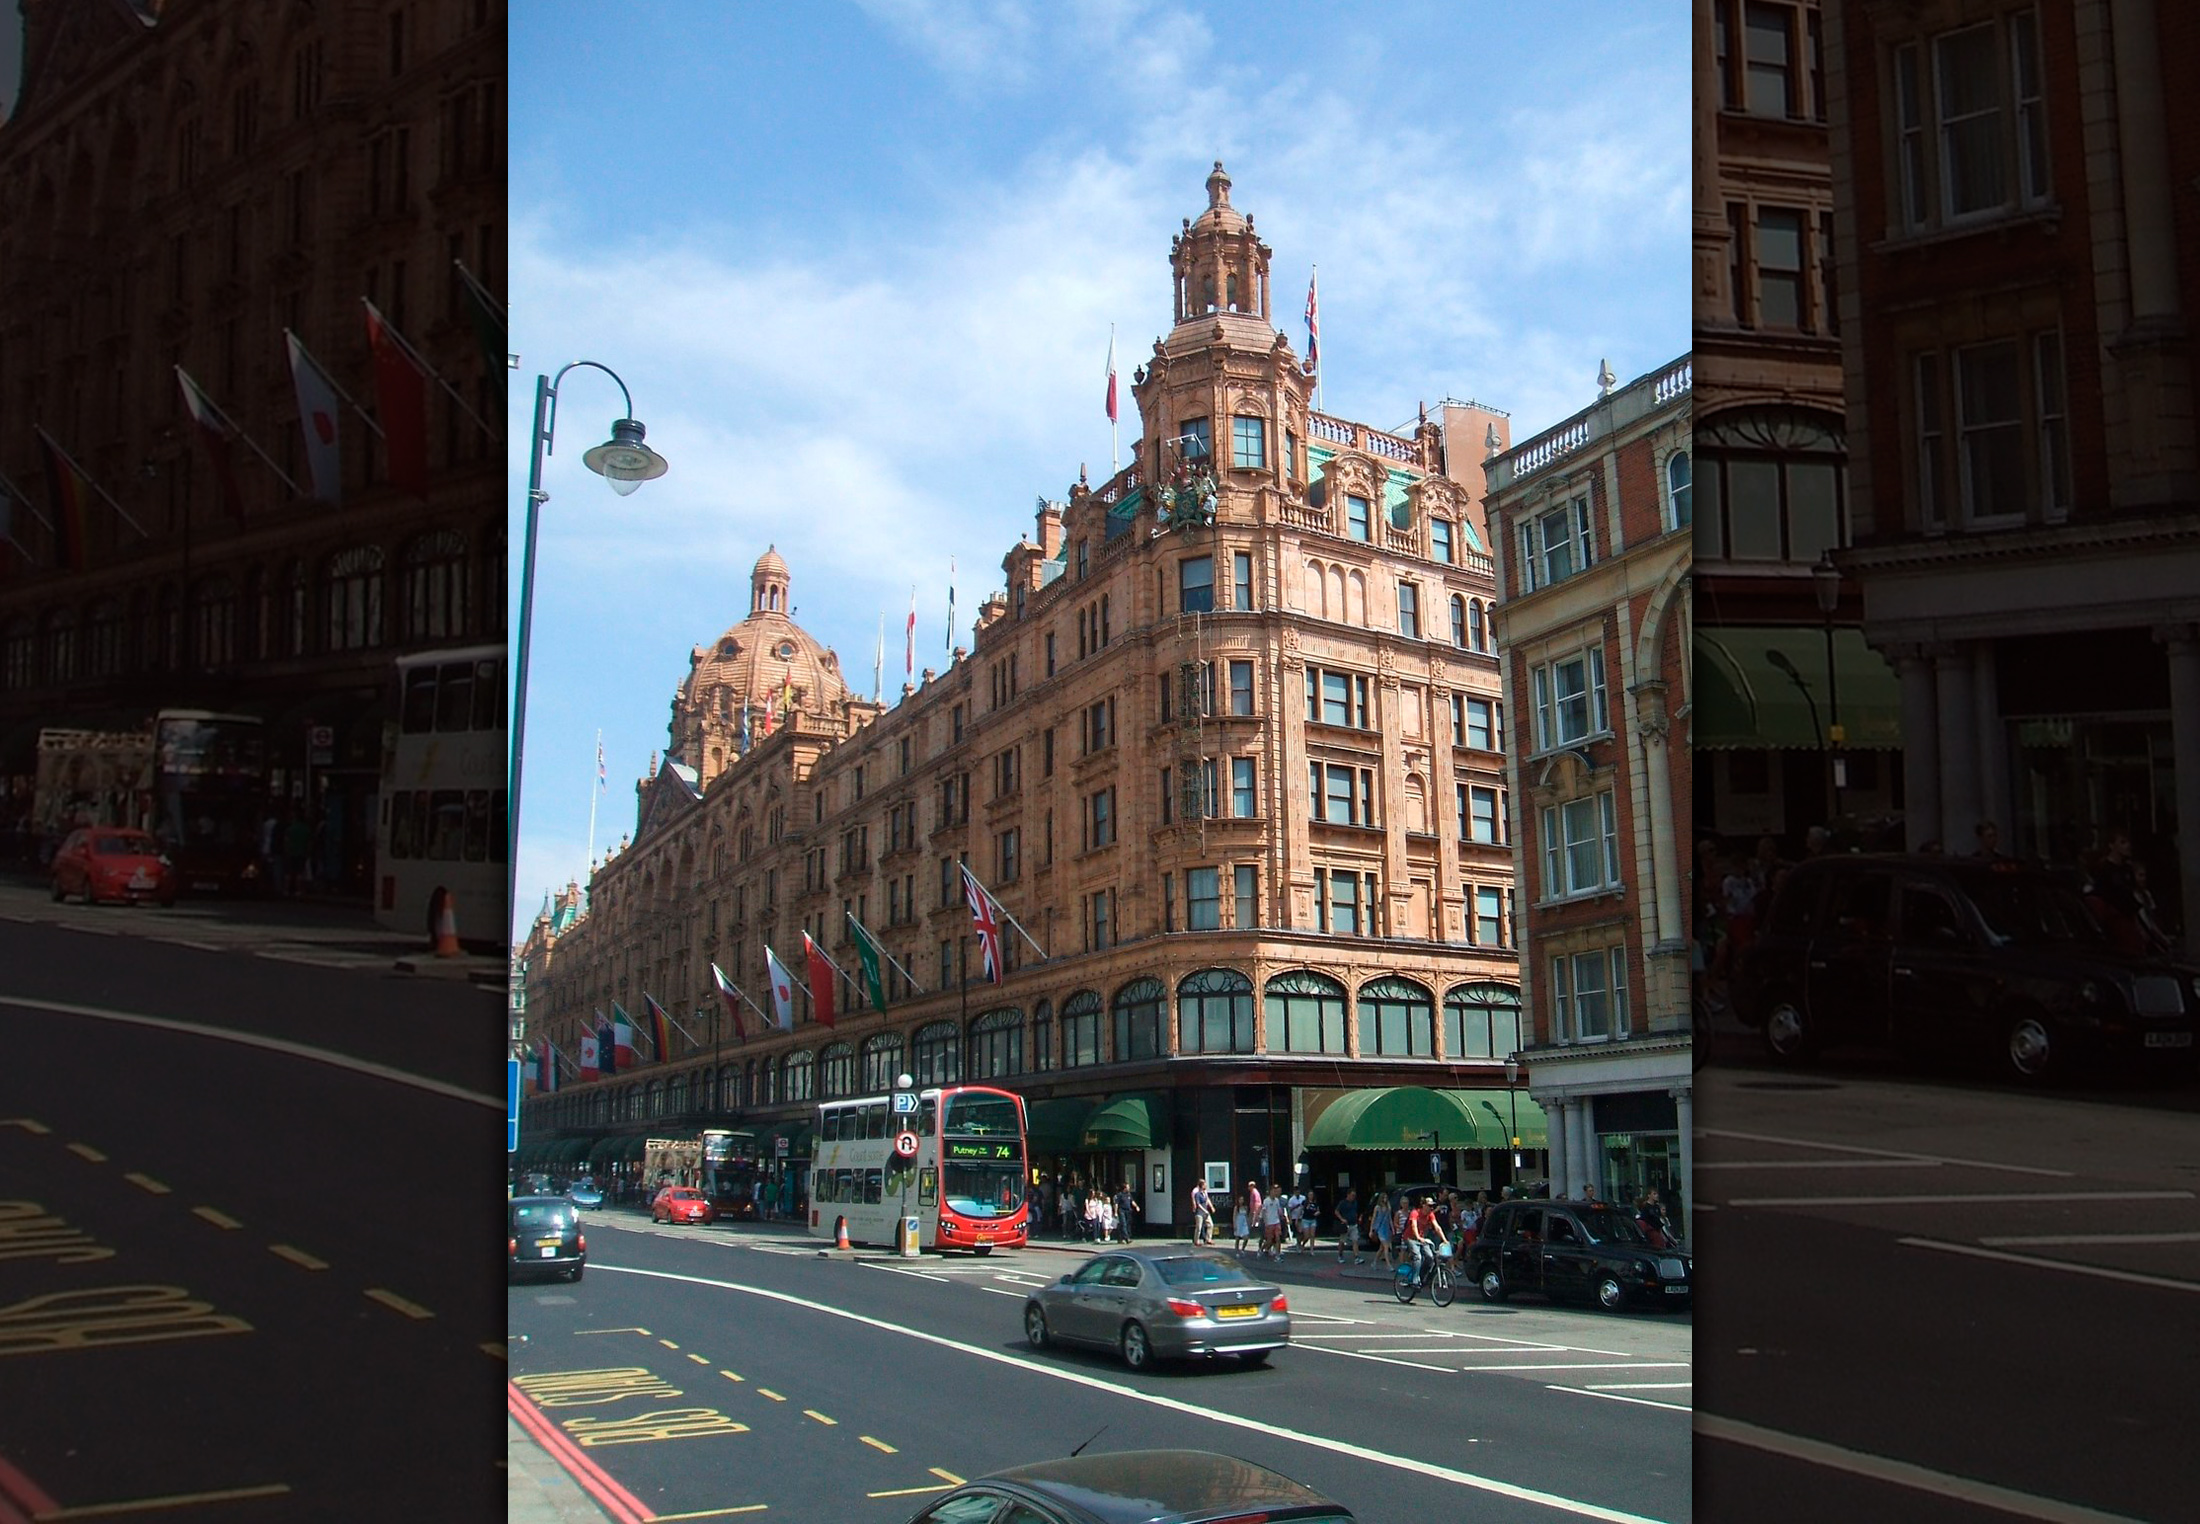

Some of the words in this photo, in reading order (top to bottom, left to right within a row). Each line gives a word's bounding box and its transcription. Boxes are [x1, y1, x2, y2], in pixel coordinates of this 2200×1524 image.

[897, 1096, 907, 1109] P
[953, 1146, 978, 1156] Putney
[996, 1146, 1010, 1158] 74
[561, 1408, 750, 1446] BUS
